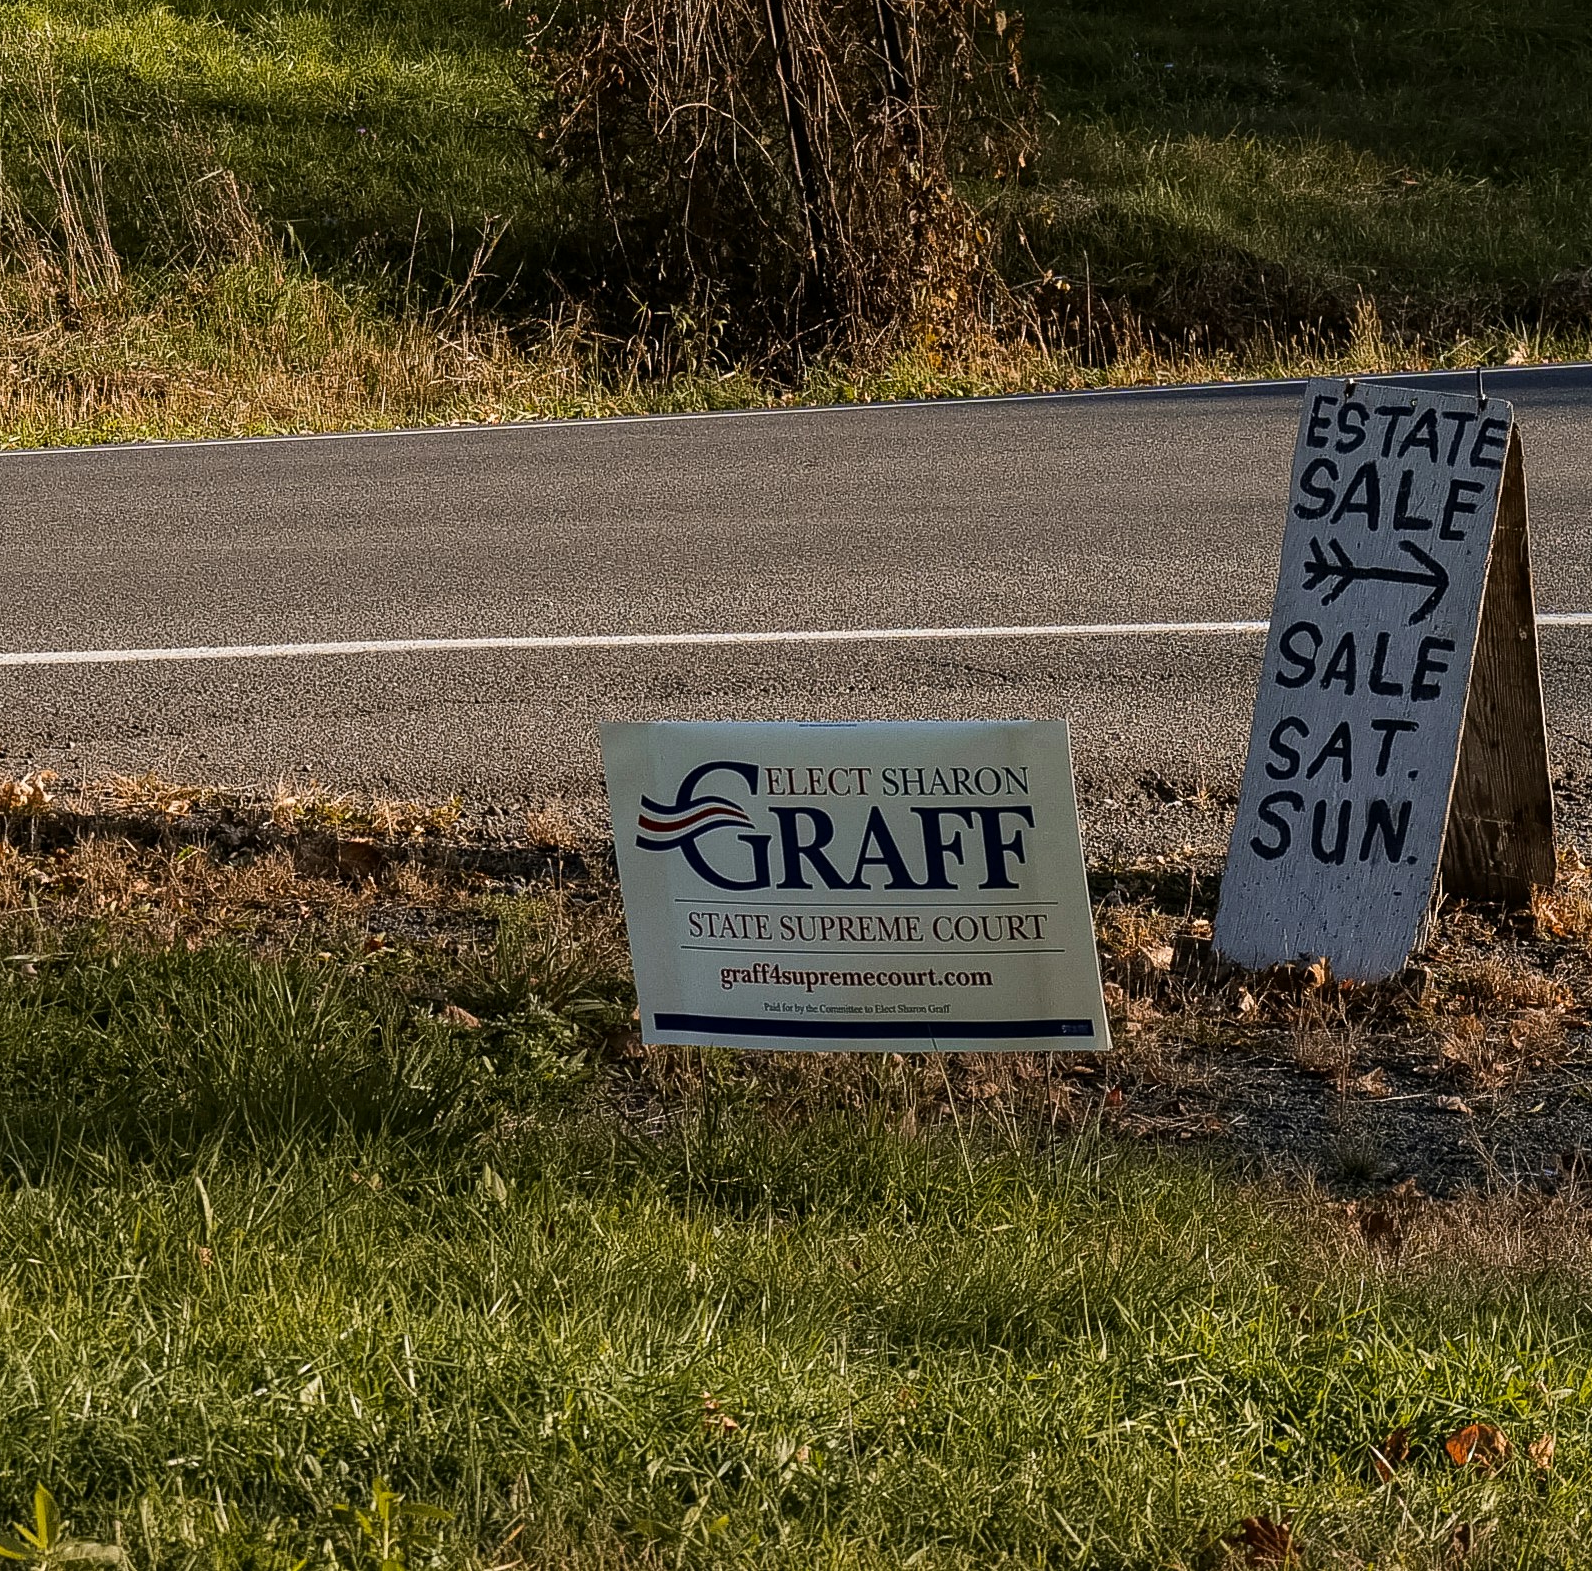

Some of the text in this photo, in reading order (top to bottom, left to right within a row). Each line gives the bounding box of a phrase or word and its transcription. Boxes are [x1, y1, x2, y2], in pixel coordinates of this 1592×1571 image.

[1306, 395, 1507, 469] ESTATE
[1293, 458, 1485, 542] SALE
[1275, 621, 1456, 702] SALE
[766, 765, 1029, 795] ELECT SHARON
[1265, 715, 1419, 783] SAT.
[635, 760, 1035, 891] GRAFF
[1250, 791, 1418, 865] SUN.
[689, 911, 1047, 942] STATE SUPREME COURT
[720, 962, 994, 993] graff4supremecourt.com
[764, 1002, 951, 1015] Paid for by the Committee to Elect Sharon Graff
